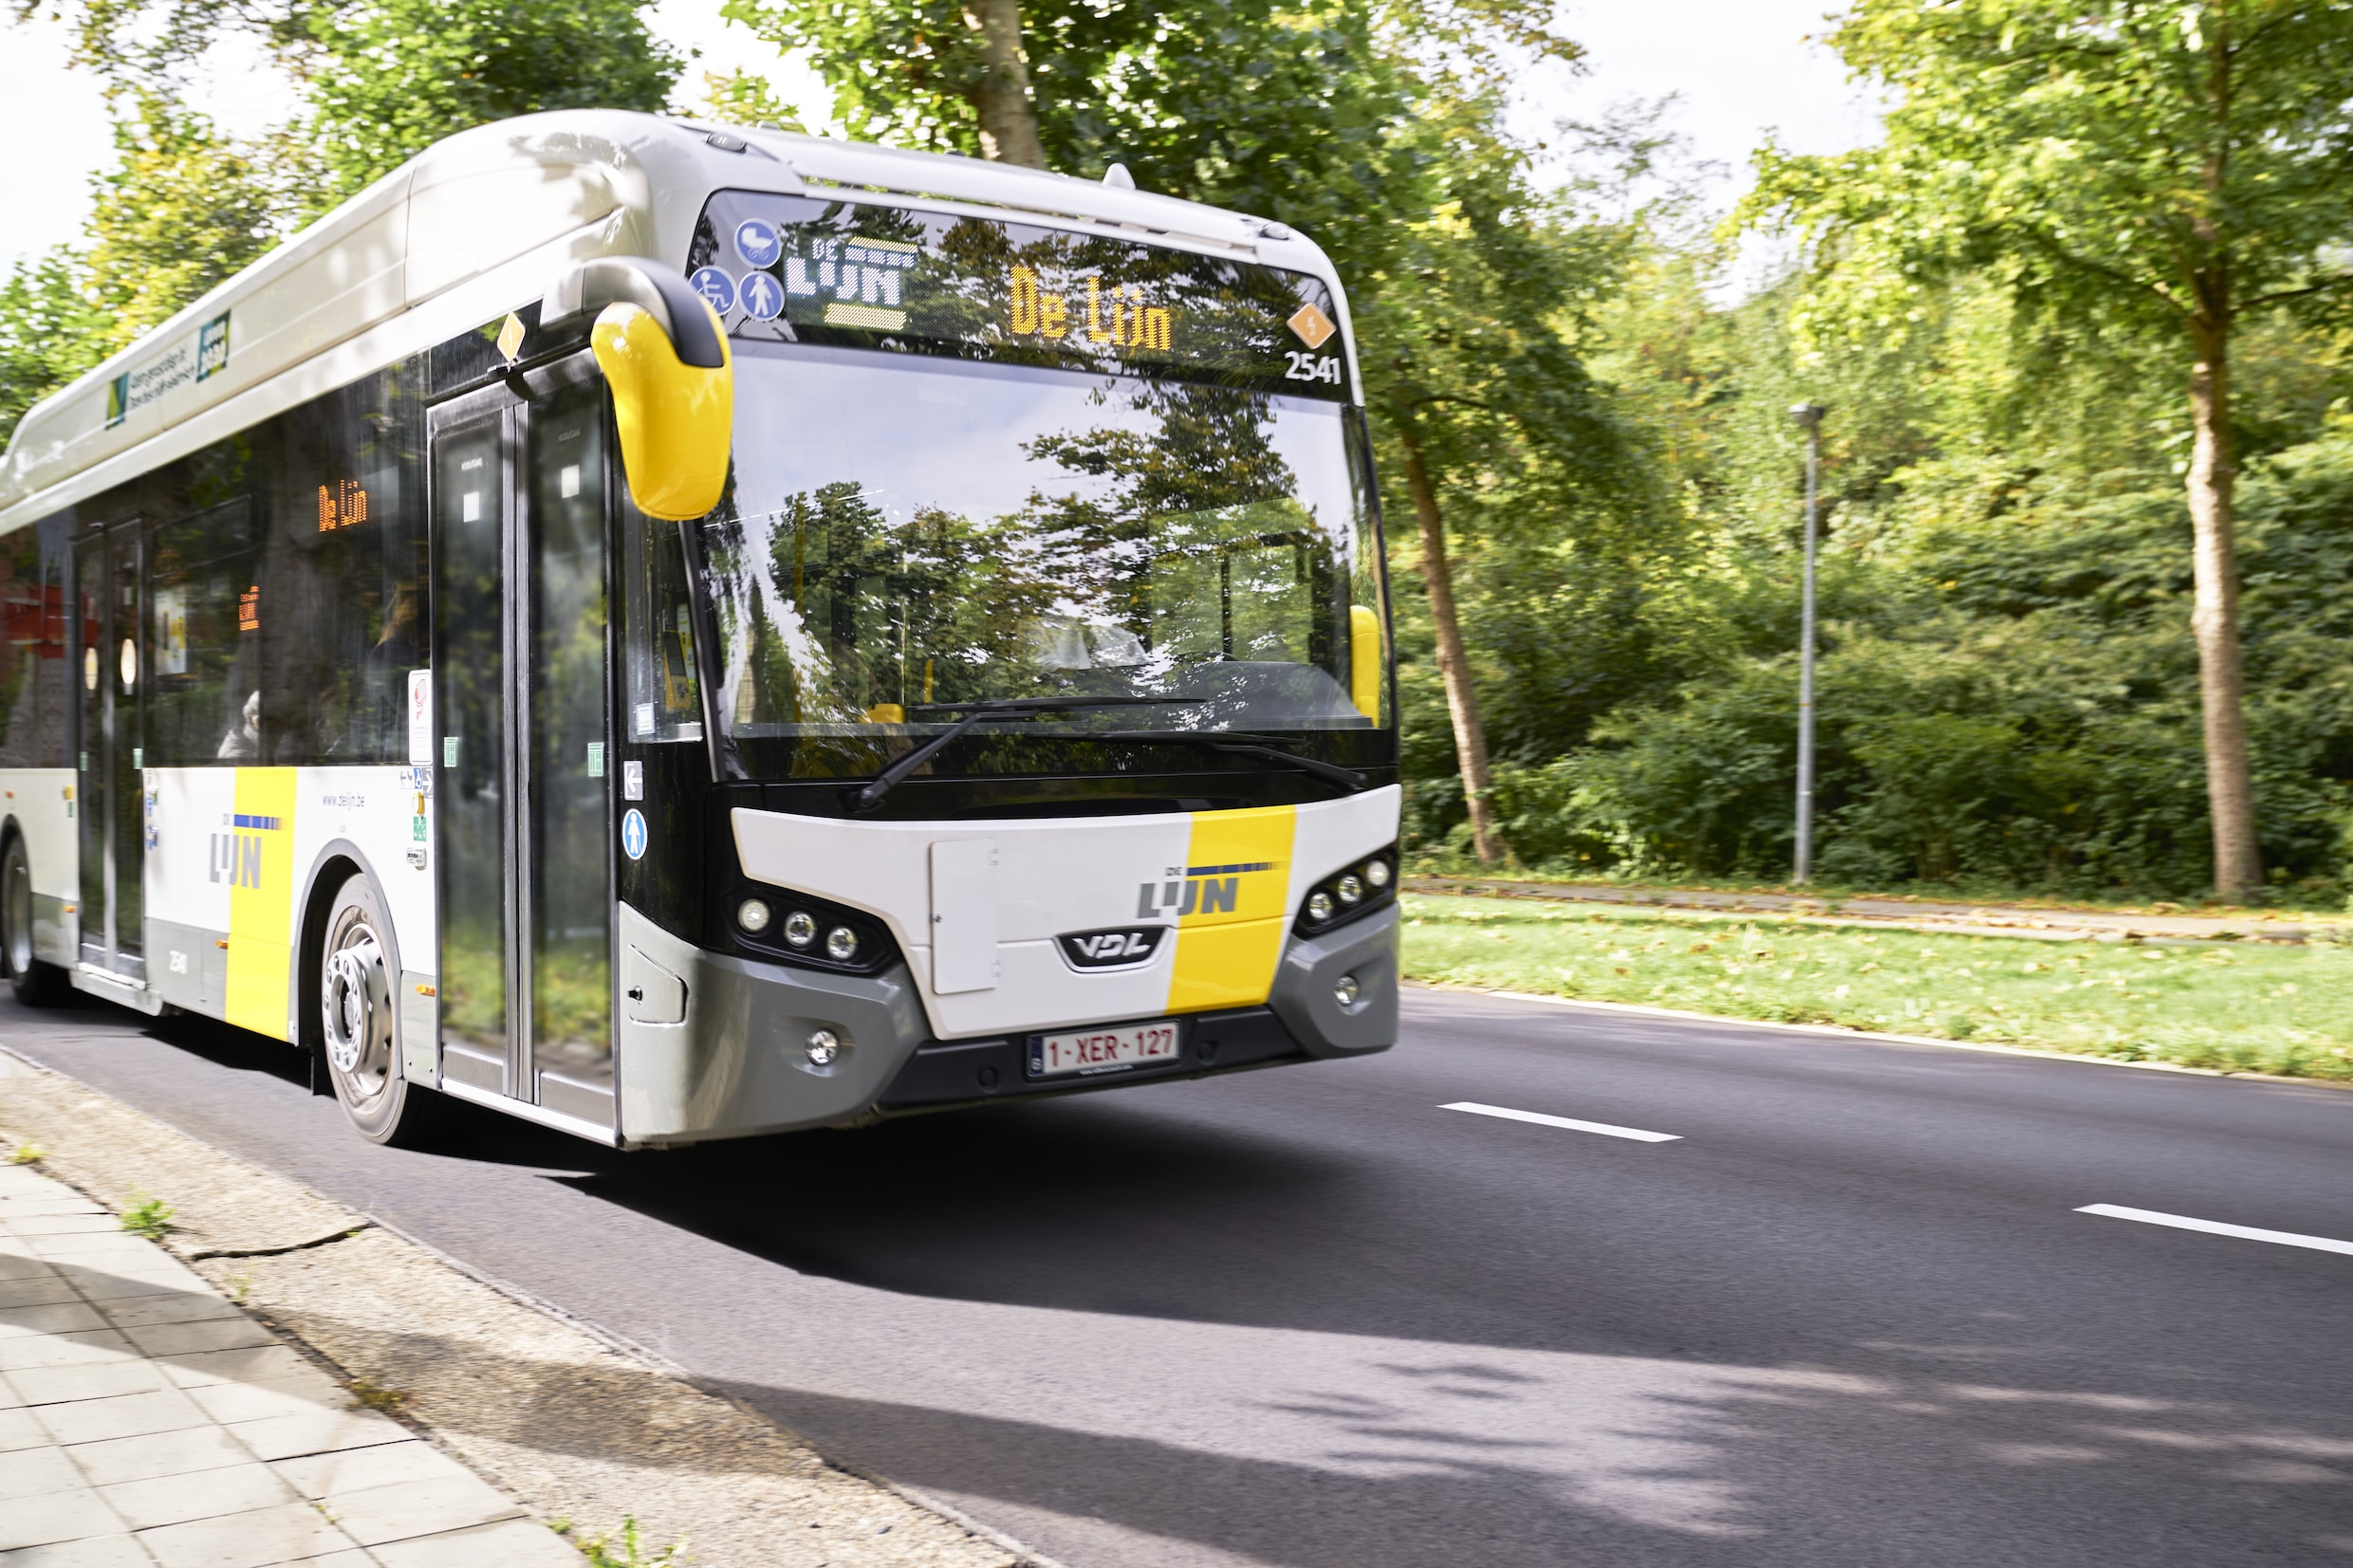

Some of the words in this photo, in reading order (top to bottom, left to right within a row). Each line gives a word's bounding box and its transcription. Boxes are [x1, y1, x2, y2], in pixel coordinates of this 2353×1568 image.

[812, 238, 838, 262] DE
[787, 257, 900, 305] LIJN
[1010, 265, 1066, 339] De
[1087, 276, 1171, 350] Lijn
[1285, 351, 1342, 385] 2541
[1166, 867, 1183, 876] DE
[1137, 877, 1238, 918] LIJN
[1072, 932, 1151, 959] VDL
[1048, 1028, 1173, 1067] 1-XER-127
